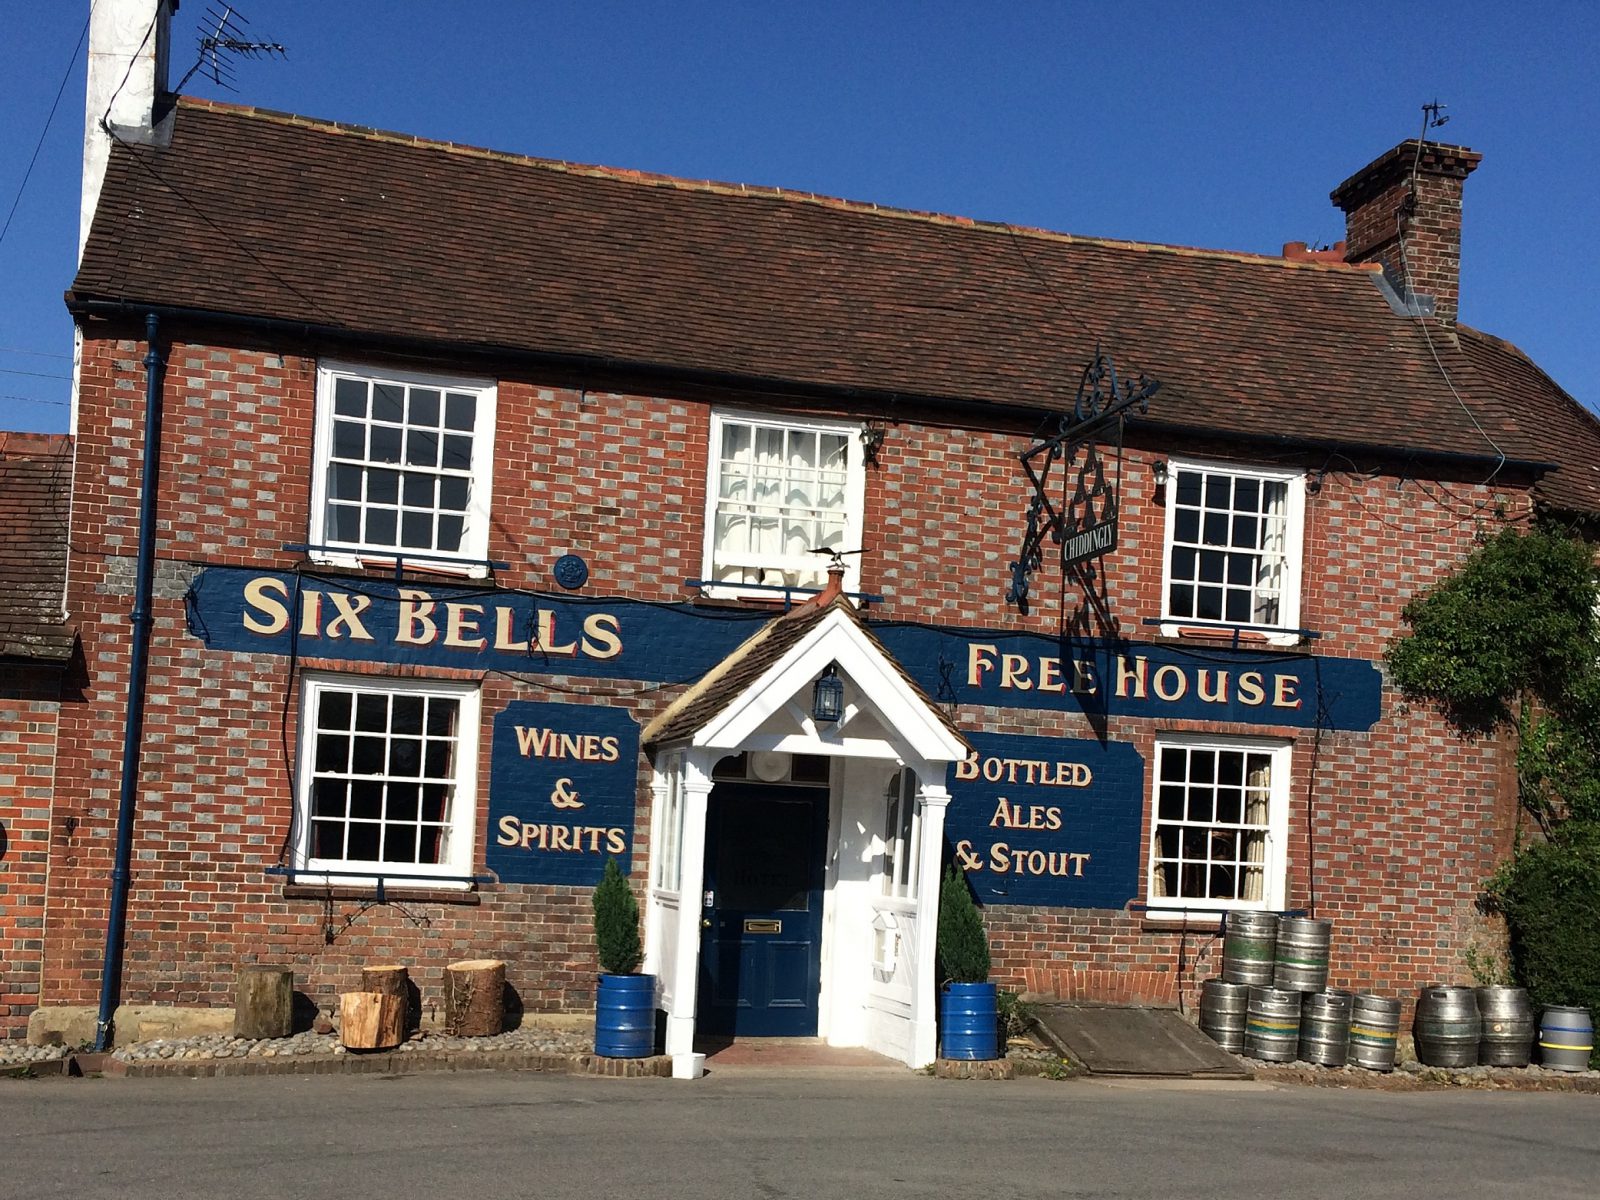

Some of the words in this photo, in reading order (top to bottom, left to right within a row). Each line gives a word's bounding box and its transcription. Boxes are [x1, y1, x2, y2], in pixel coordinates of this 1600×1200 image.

[1064, 523, 1114, 561] CHIDDINGLY
[243, 576, 375, 641] SIX
[395, 588, 623, 660] BELLS
[967, 643, 1098, 695] FREE
[1115, 655, 1303, 708] HOUSE
[514, 725, 619, 762] WINES
[955, 751, 1093, 788] BOTTLED
[550, 778, 586, 810] &
[989, 797, 1063, 831] ALES
[497, 815, 627, 854] SPIRITS
[954, 840, 984, 871] &
[989, 842, 1092, 877] STOUT
